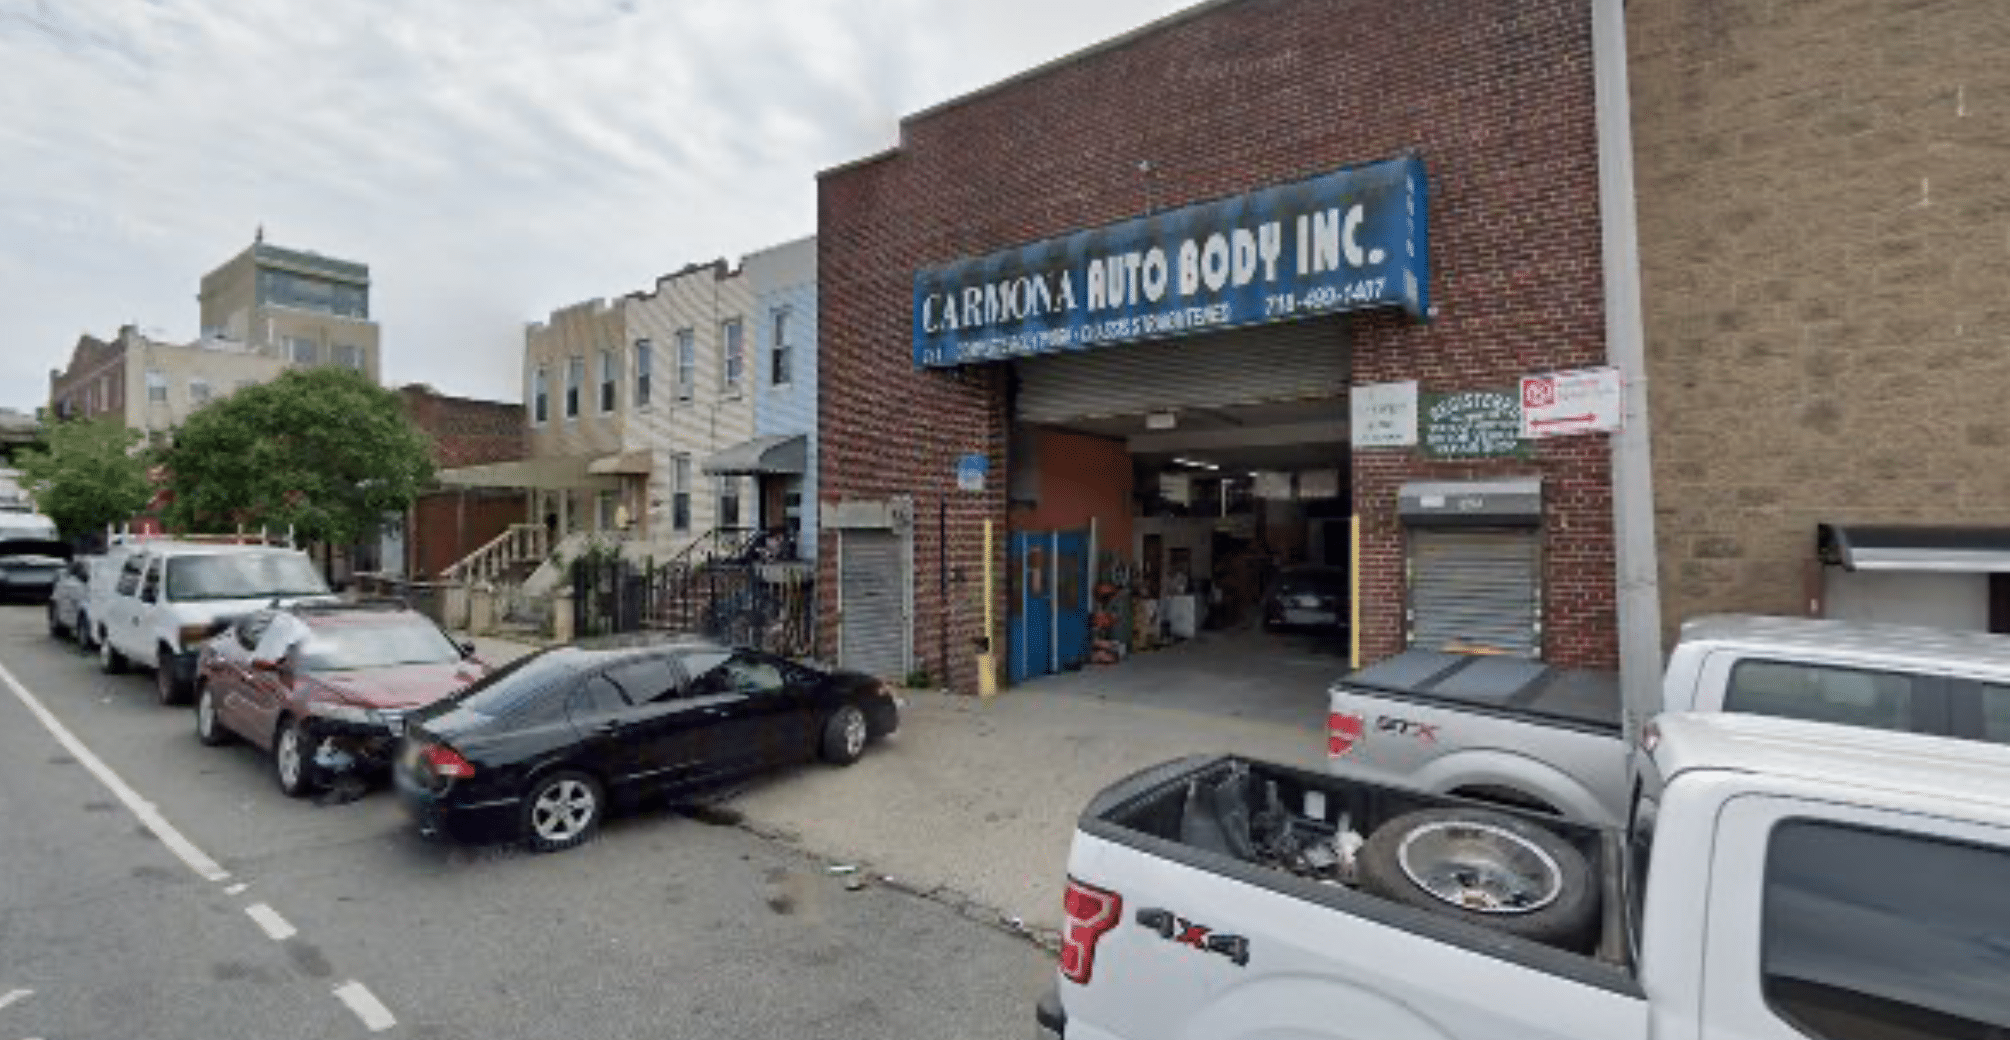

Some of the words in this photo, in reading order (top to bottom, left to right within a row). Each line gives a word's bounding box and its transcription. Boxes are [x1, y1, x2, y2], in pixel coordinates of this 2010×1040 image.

[922, 270, 1078, 333] CARMONA
[1088, 246, 1168, 312] AUTO
[1179, 222, 1282, 297] BODY
[1297, 205, 1386, 276] INC.
